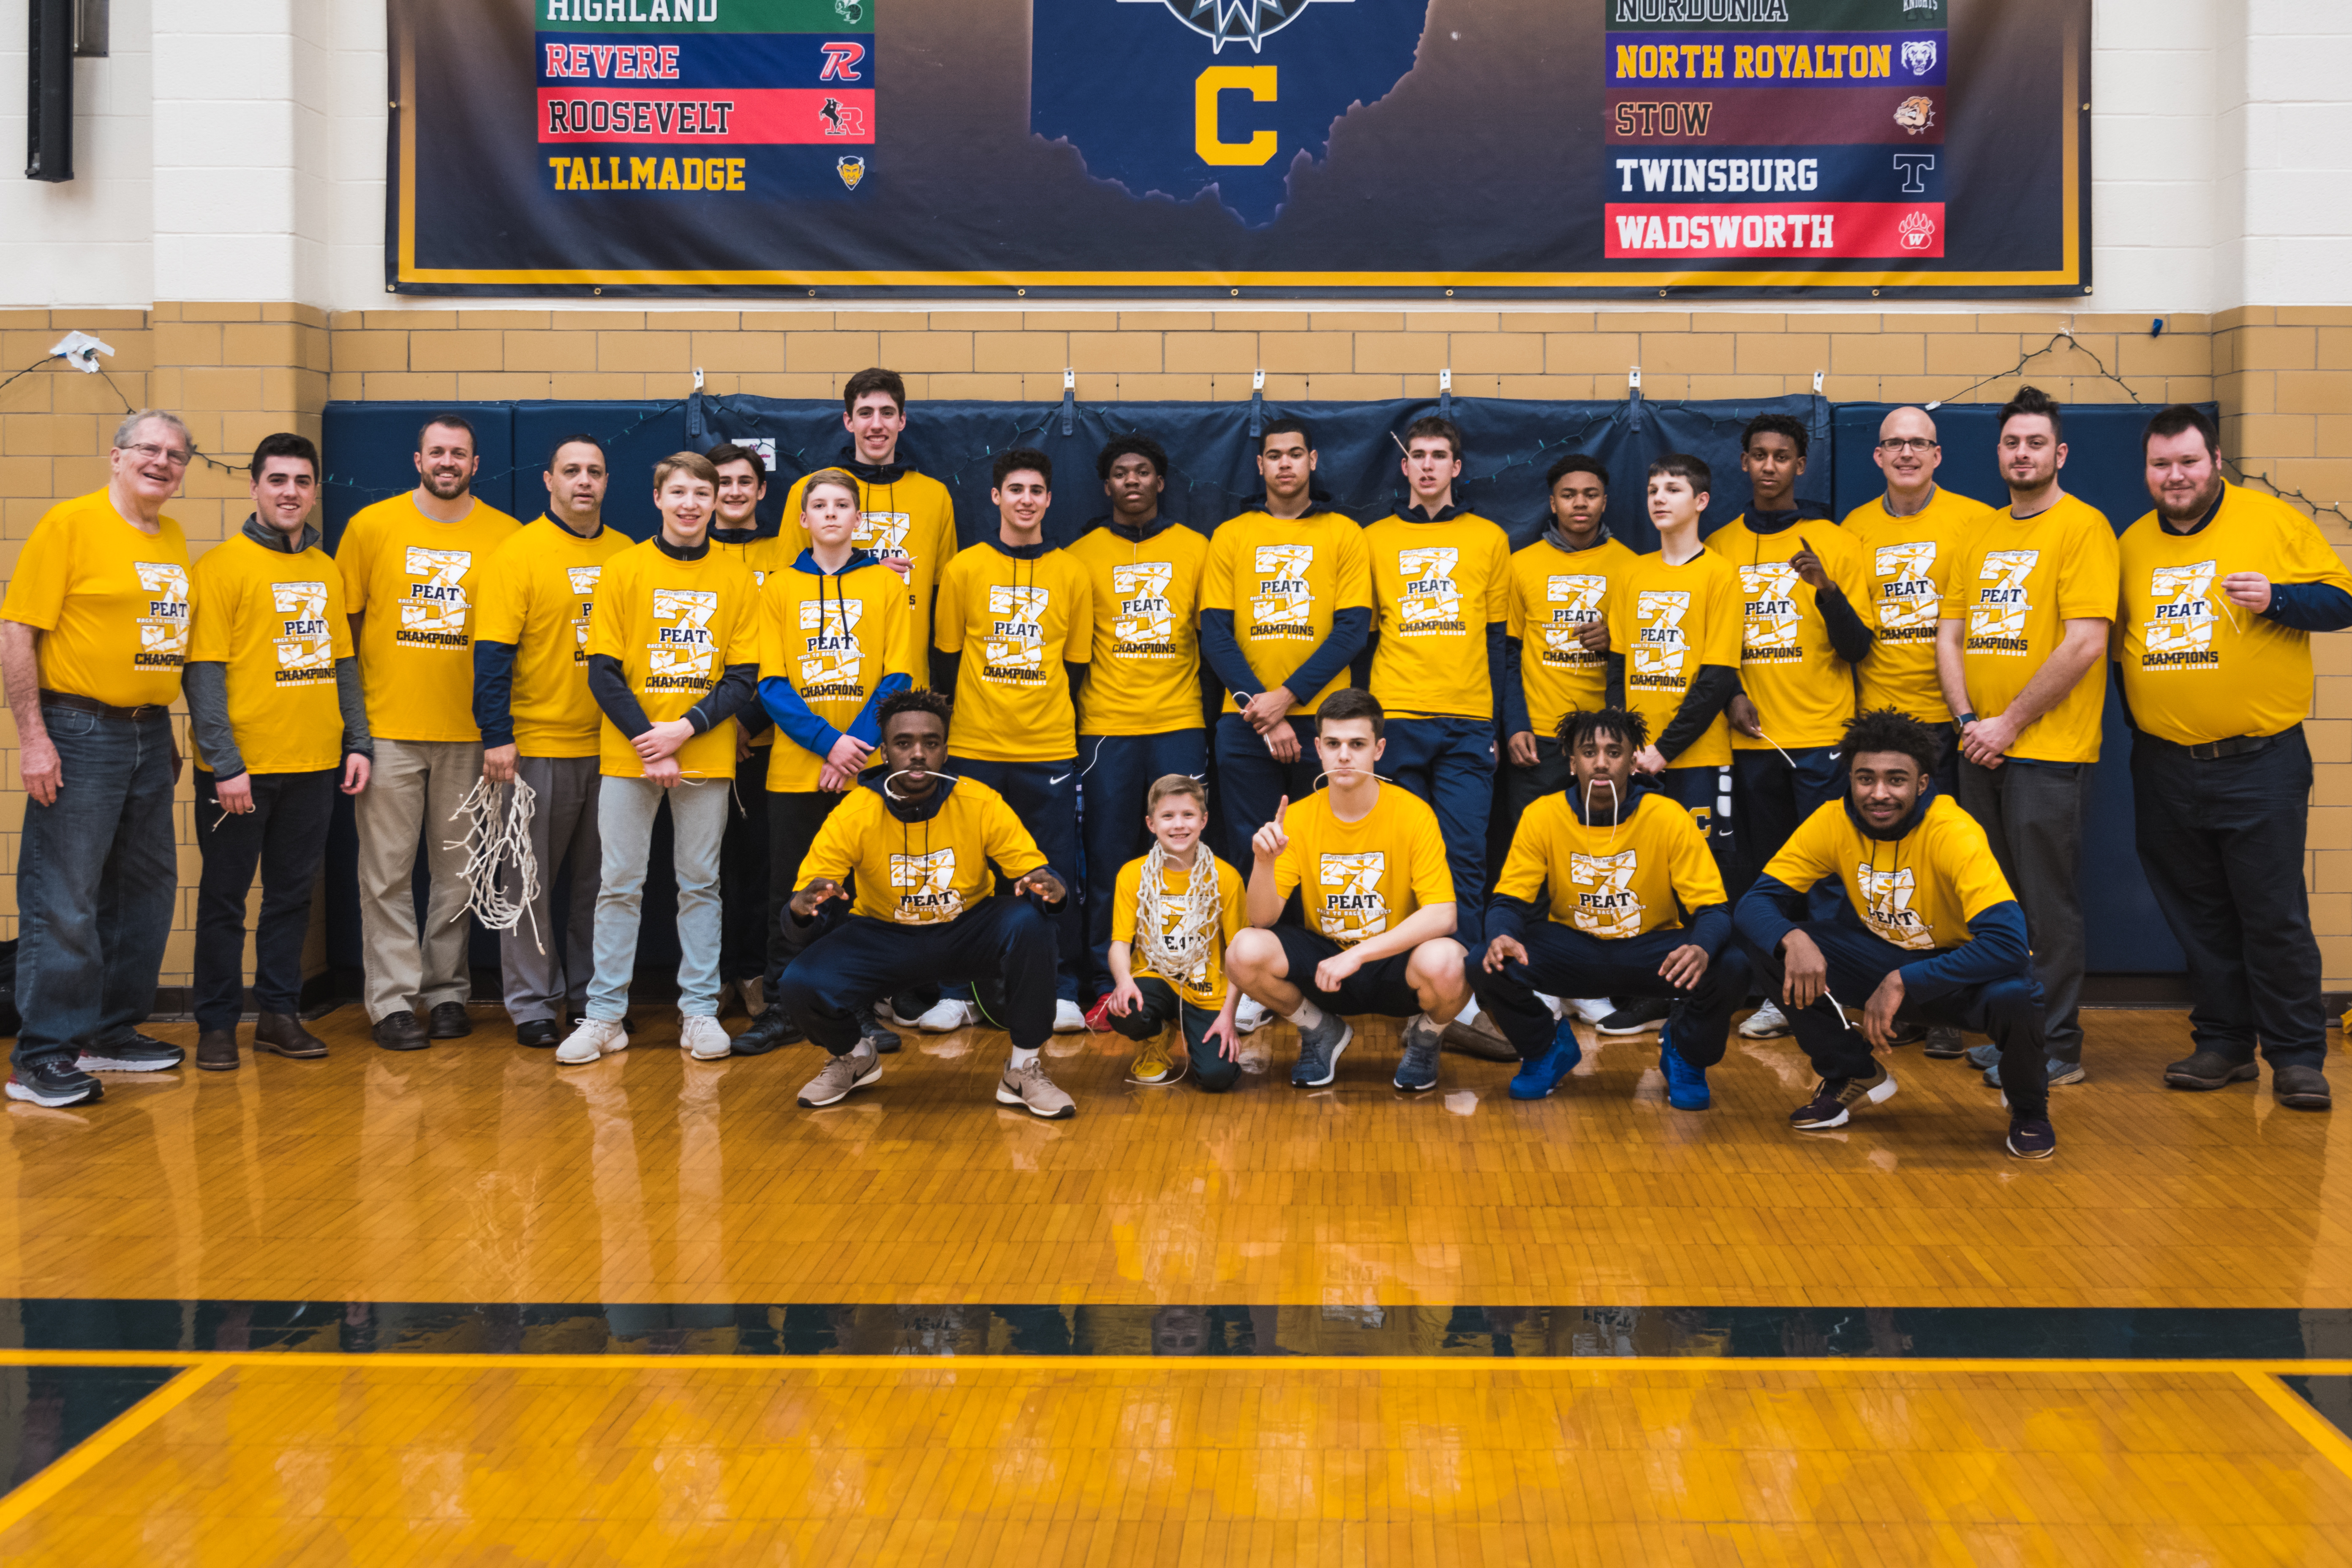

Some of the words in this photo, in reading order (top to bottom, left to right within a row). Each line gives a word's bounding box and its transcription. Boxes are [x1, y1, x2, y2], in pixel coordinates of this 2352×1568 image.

[547, 0, 718, 22] HIGHLAND
[1616, 0, 1788, 22] NORDONIA
[545, 44, 680, 79] REVERE
[1616, 44, 1724, 79] NORTH
[1734, 44, 1892, 79] ROYALTON
[548, 101, 734, 136] ROOSEVELT
[1195, 65, 1277, 166] C
[1615, 102, 1712, 136] STOW
[549, 157, 746, 191] TALLMADGE
[1616, 158, 1818, 192] TWINSBURG
[1894, 154, 1935, 193] T
[1616, 215, 1835, 249] WADSWORTH
[1908, 233, 1925, 246] W
[412, 584, 460, 601] PEAT
[1261, 580, 1304, 593] PEAT
[1408, 579, 1450, 594] PEAT
[1884, 580, 1928, 597] PEAT
[1980, 589, 2022, 603] PEAT
[150, 601, 187, 617] PEAT
[1122, 599, 1163, 614] PEAT
[1745, 601, 1789, 615] PEAT
[2156, 601, 2205, 618] PEAT
[1554, 610, 1597, 622] PEAT
[284, 621, 324, 635] PEAT
[994, 622, 1038, 637] PEAT
[1250, 624, 1314, 636] CHAMPIONS
[1399, 621, 1466, 632] CHAMPIONS
[1881, 627, 1938, 640] CHAMPION
[397, 631, 468, 646] CHAMPIONS
[660, 628, 707, 643] PEAT
[1641, 629, 1679, 642] PEAT
[807, 637, 853, 652] PEAT
[1112, 643, 1176, 653] CHAMPIONS
[1742, 647, 1803, 660] HAMPIONS
[2142, 651, 2219, 666] CHAMPIONS
[983, 666, 1047, 681] CHAMPIONS
[646, 676, 714, 690] CHAMPIONS
[800, 684, 864, 698] CHAMPIONS
[900, 891, 953, 906] PEAT
[1328, 895, 1377, 909] PEAT
[1579, 893, 1631, 908] PEAT
